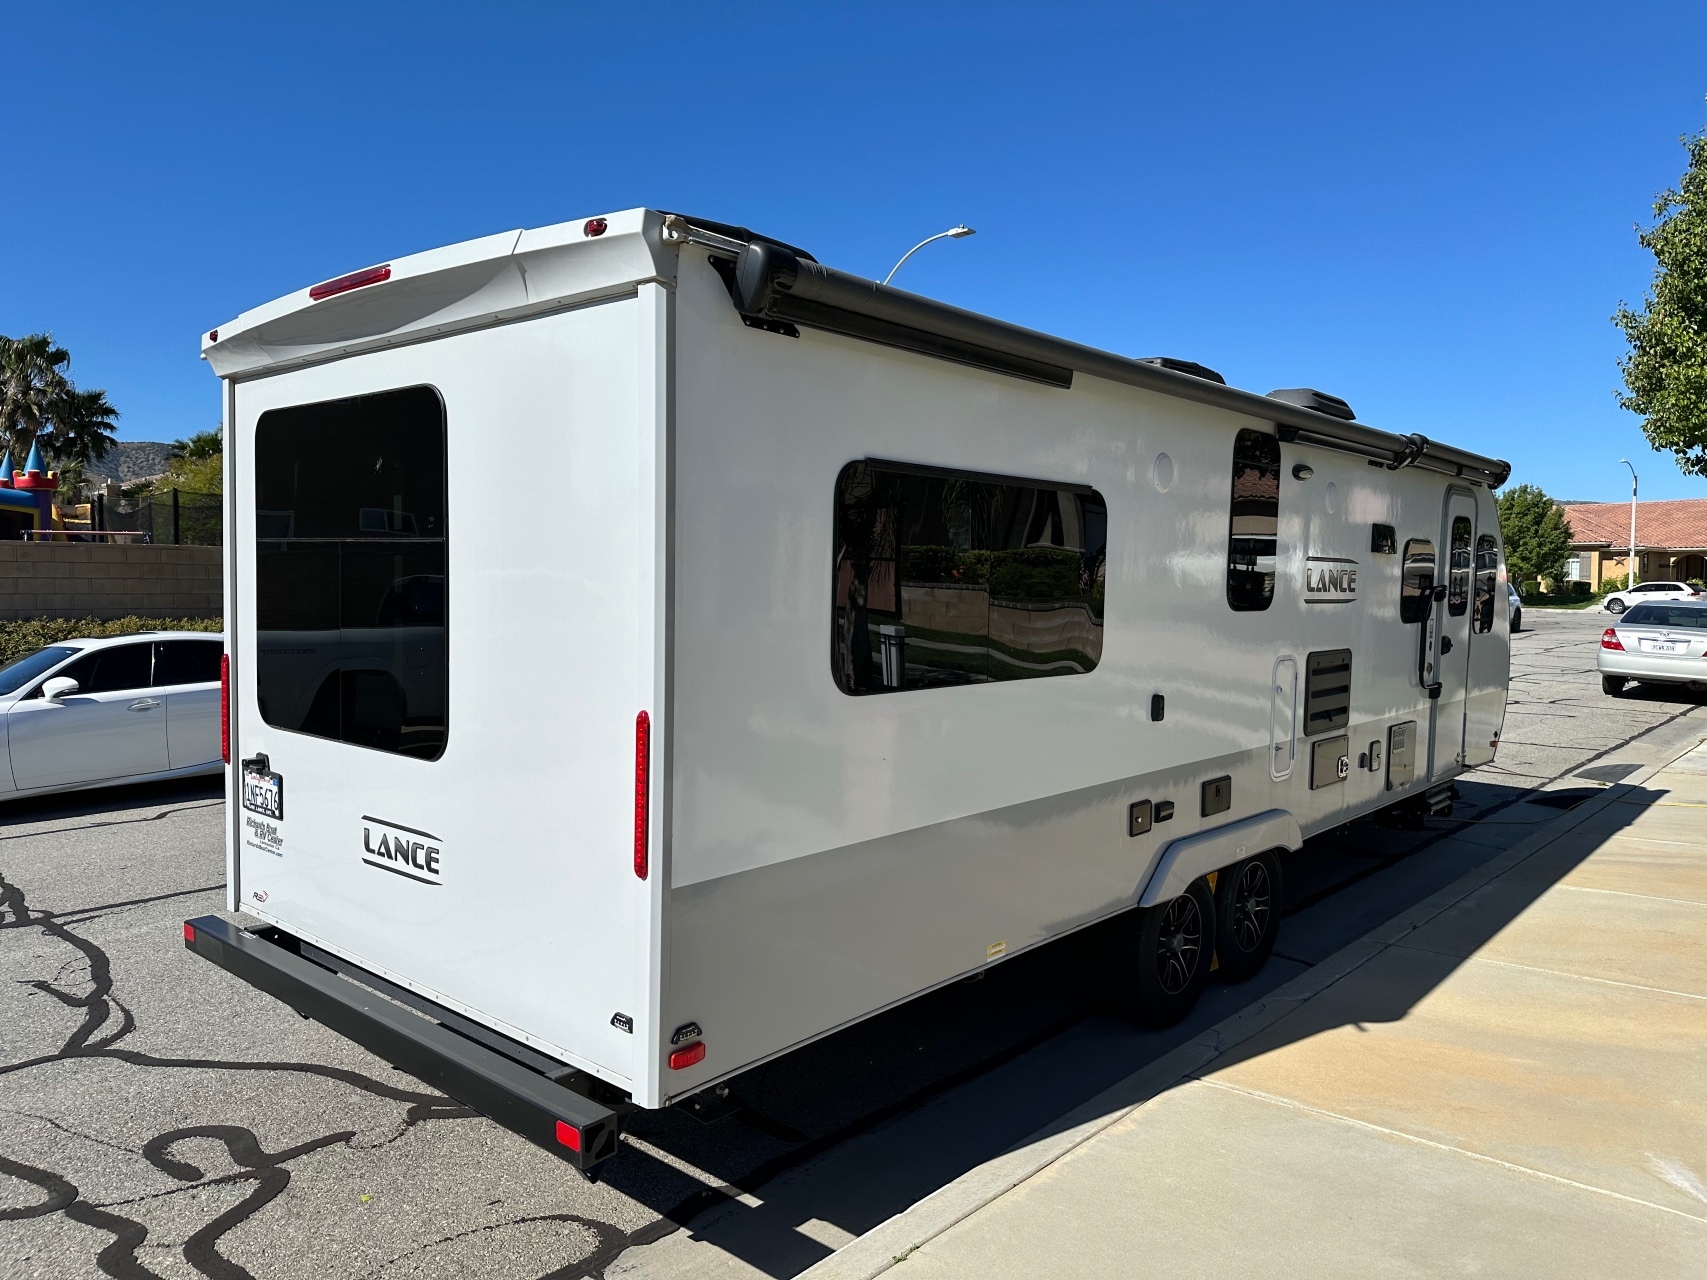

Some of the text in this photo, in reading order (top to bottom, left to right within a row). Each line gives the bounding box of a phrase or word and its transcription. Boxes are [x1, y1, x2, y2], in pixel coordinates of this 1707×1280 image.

[1306, 568, 1357, 592] LANCE
[246, 782, 279, 811] 1NF5676
[259, 830, 267, 840] RV
[363, 827, 440, 875] LANCE
